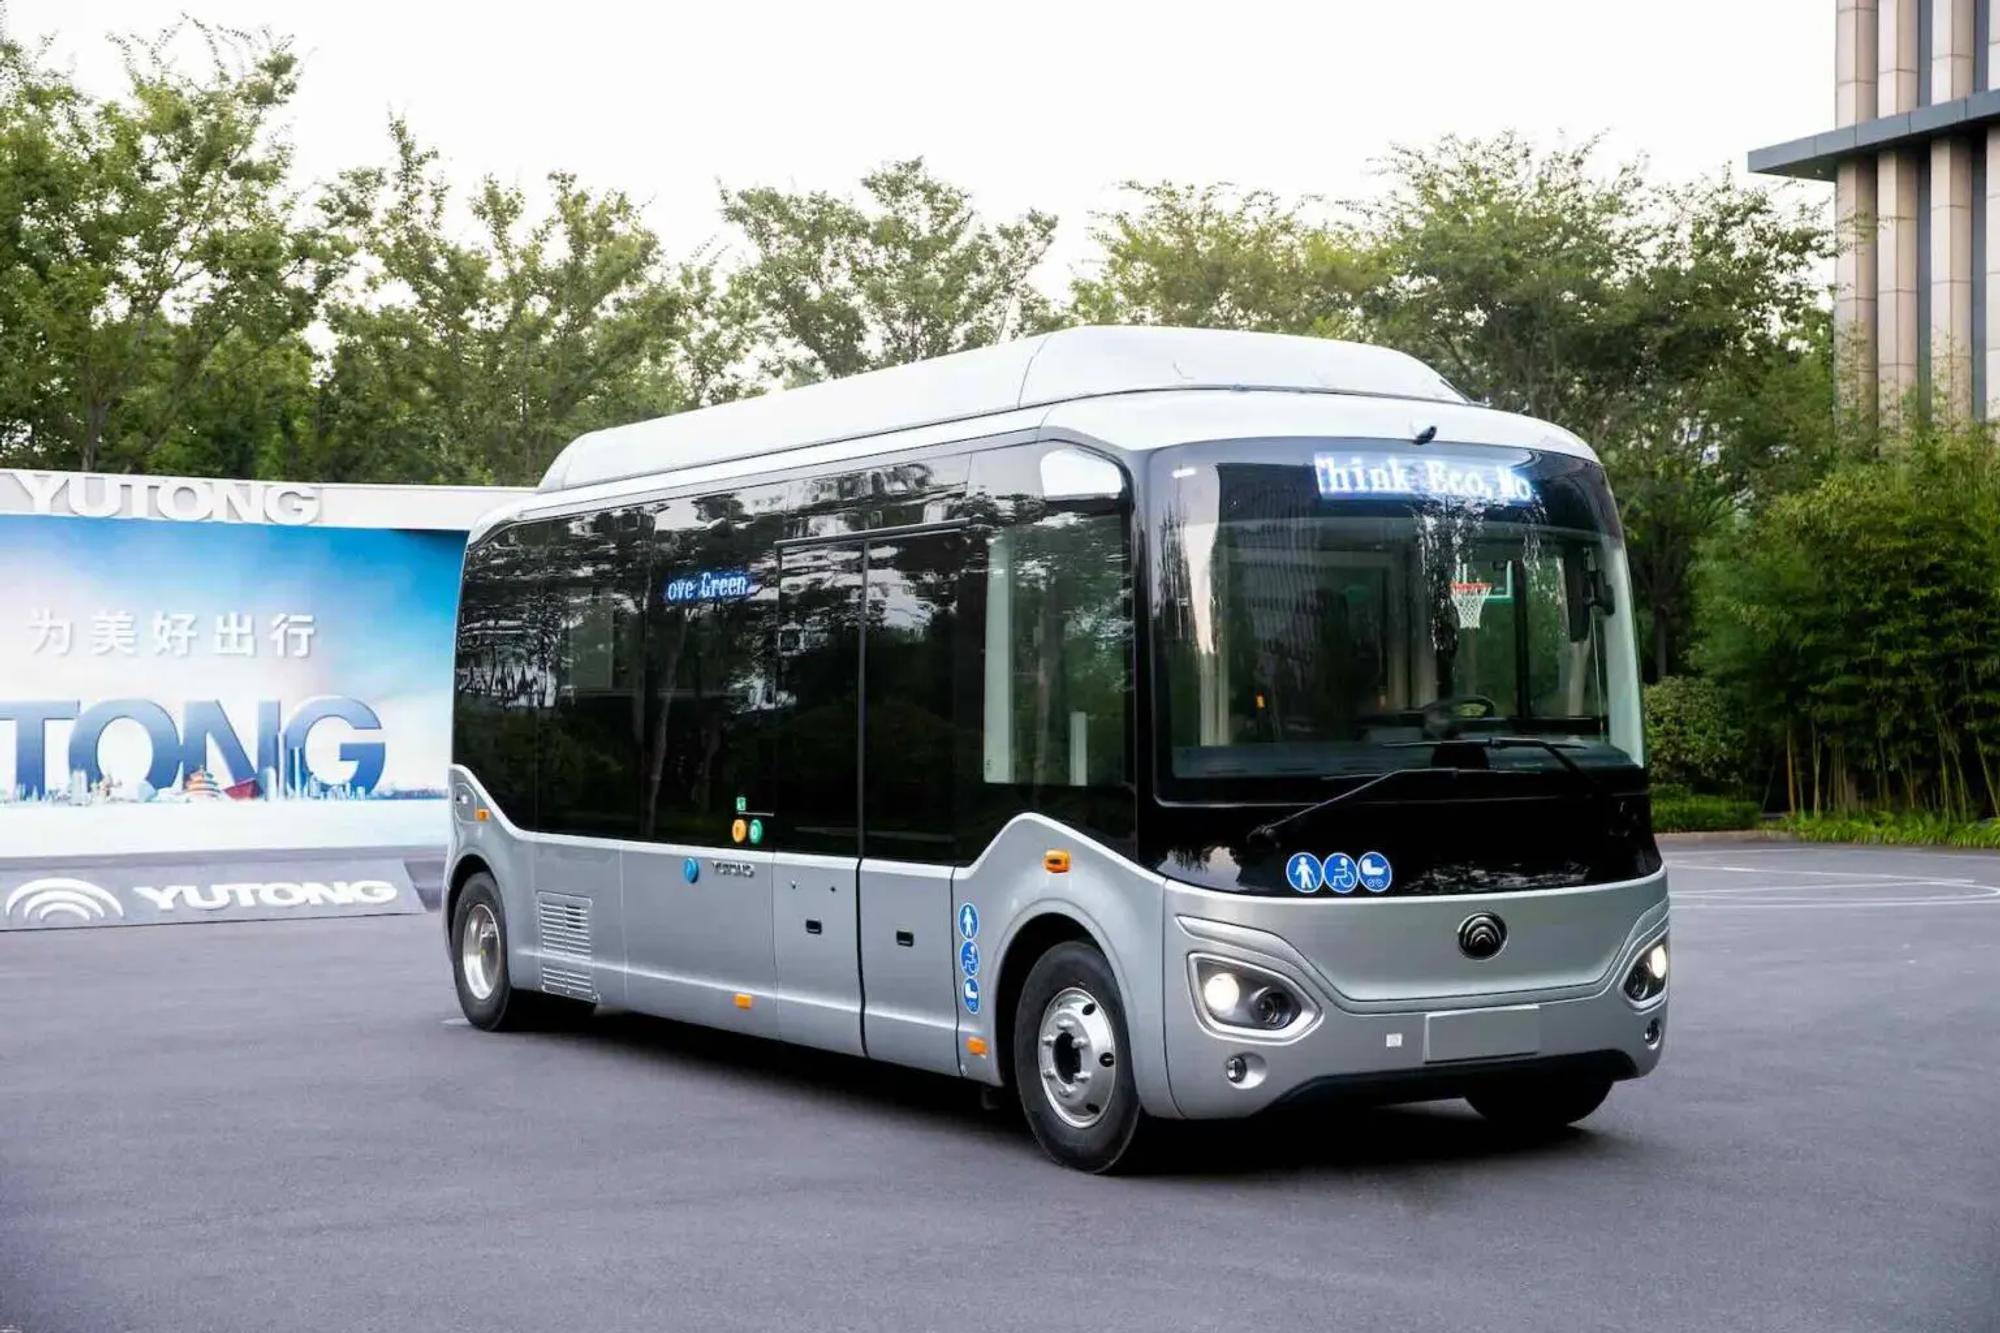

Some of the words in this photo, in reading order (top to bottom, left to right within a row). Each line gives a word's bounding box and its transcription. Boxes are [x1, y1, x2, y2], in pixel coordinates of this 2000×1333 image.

[9, 471, 321, 526] YUTONG
[700, 572, 747, 598] Green
[28, 608, 318, 659] 为美好出行
[133, 880, 398, 911] YUTONG
